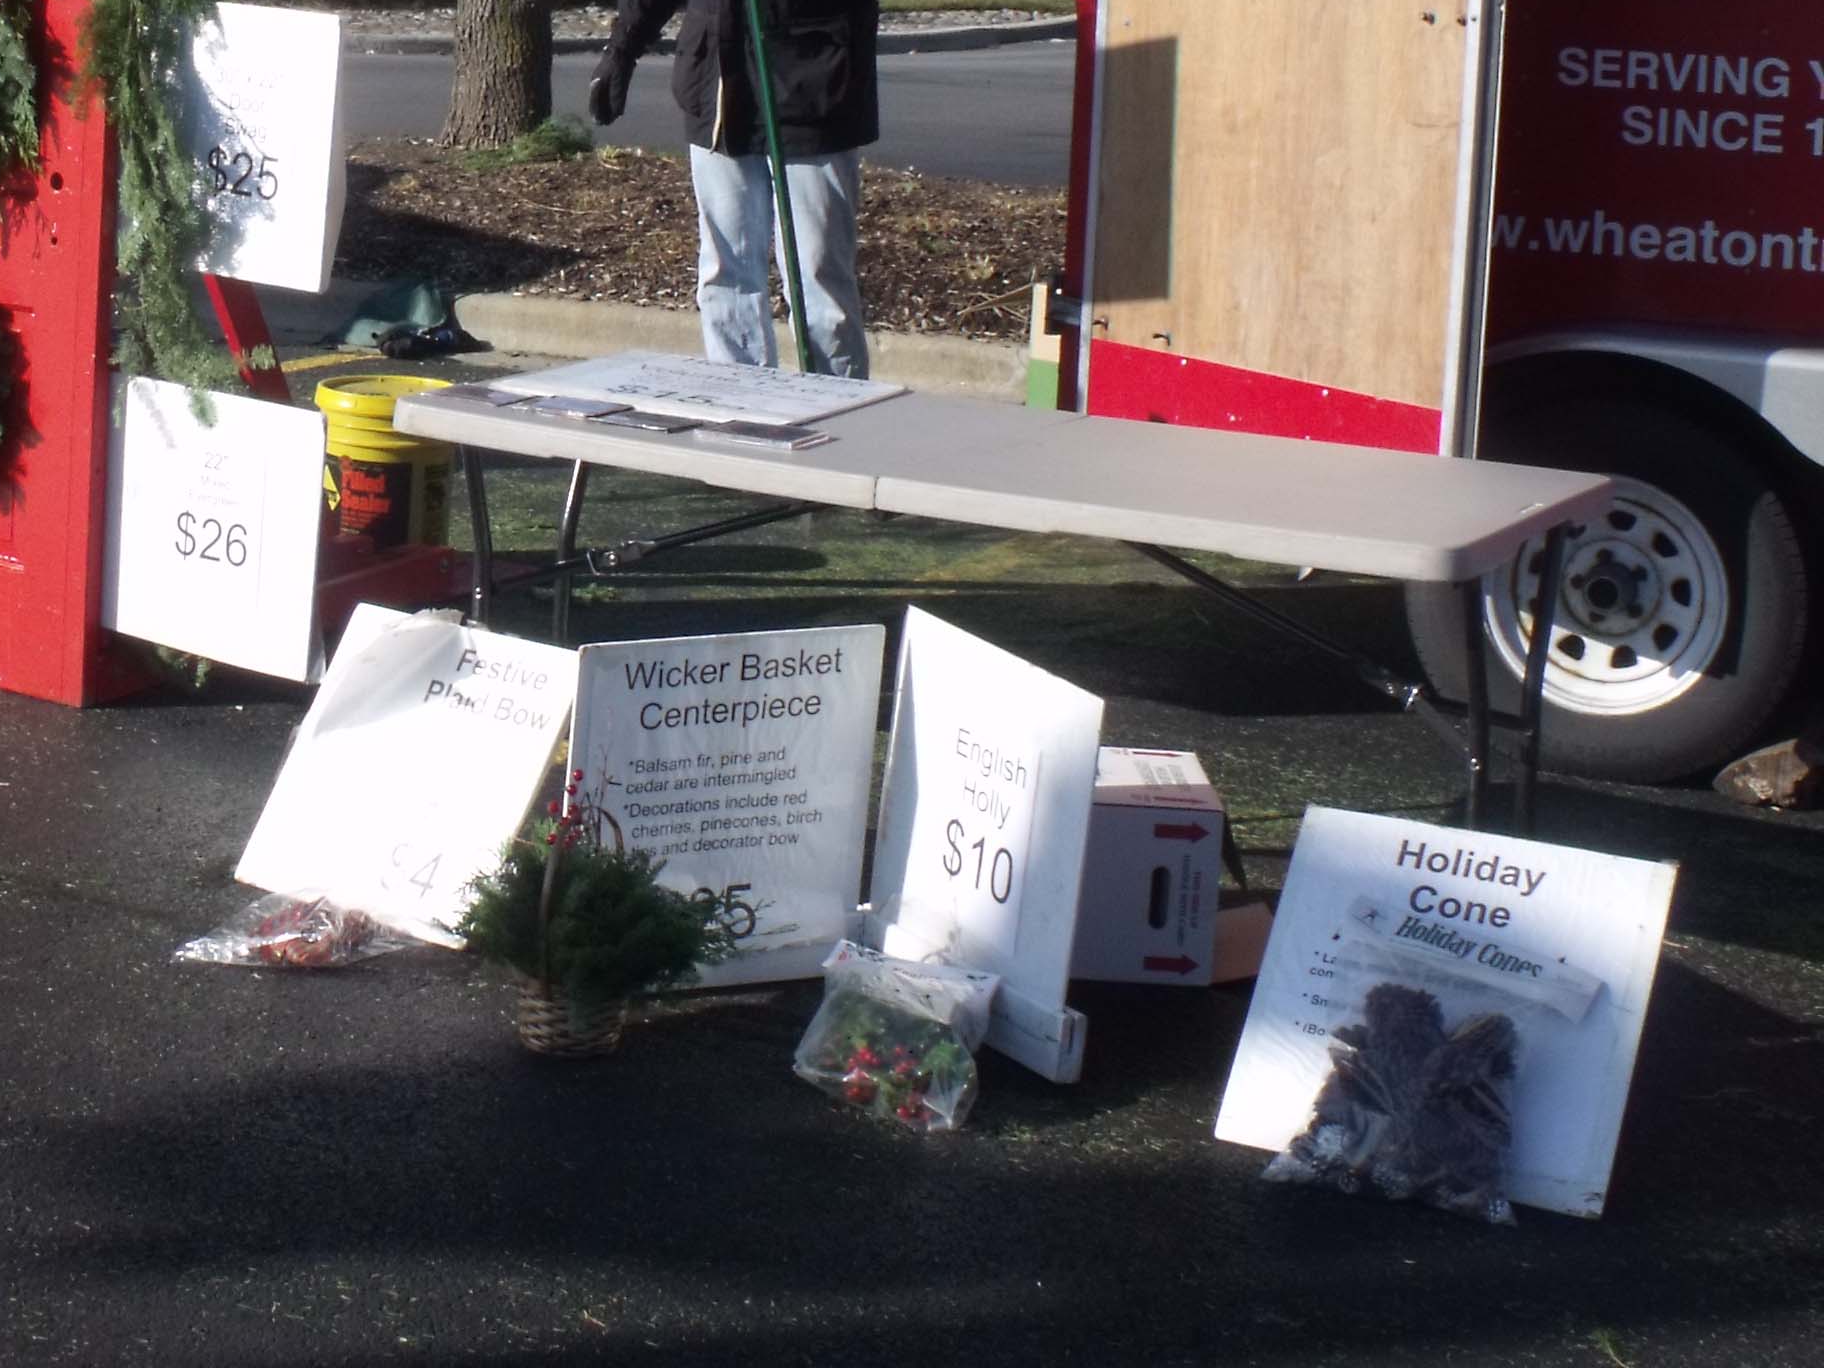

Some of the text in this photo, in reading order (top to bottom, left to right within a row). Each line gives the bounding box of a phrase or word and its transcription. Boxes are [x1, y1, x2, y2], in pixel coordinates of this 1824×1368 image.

[1557, 46, 1792, 99] SERVING
[1621, 105, 1785, 154] SINCE
[208, 145, 279, 201] $25
[1491, 209, 1824, 273] w.wheatont
[175, 510, 247, 567] $26
[456, 649, 549, 691] Festive
[625, 648, 844, 690] Wicker Basket
[494, 697, 552, 732] Bow
[639, 693, 822, 730] Centerpiece
[720, 749, 753, 767] pine
[757, 745, 787, 763] and
[956, 728, 1028, 790] English
[625, 766, 797, 795] cedar are intermingled
[725, 793, 778, 810] include
[783, 790, 808, 806] red
[786, 809, 823, 826] birch
[963, 779, 1011, 830] Holly
[661, 839, 689, 855] and
[692, 833, 765, 853] decorator
[768, 830, 801, 847] bow
[942, 818, 1014, 905] $10
[1396, 839, 1547, 898] Holiday
[1409, 885, 1512, 929] Cone
[1394, 916, 1478, 960] Holiday
[1477, 942, 1545, 978] Cones
